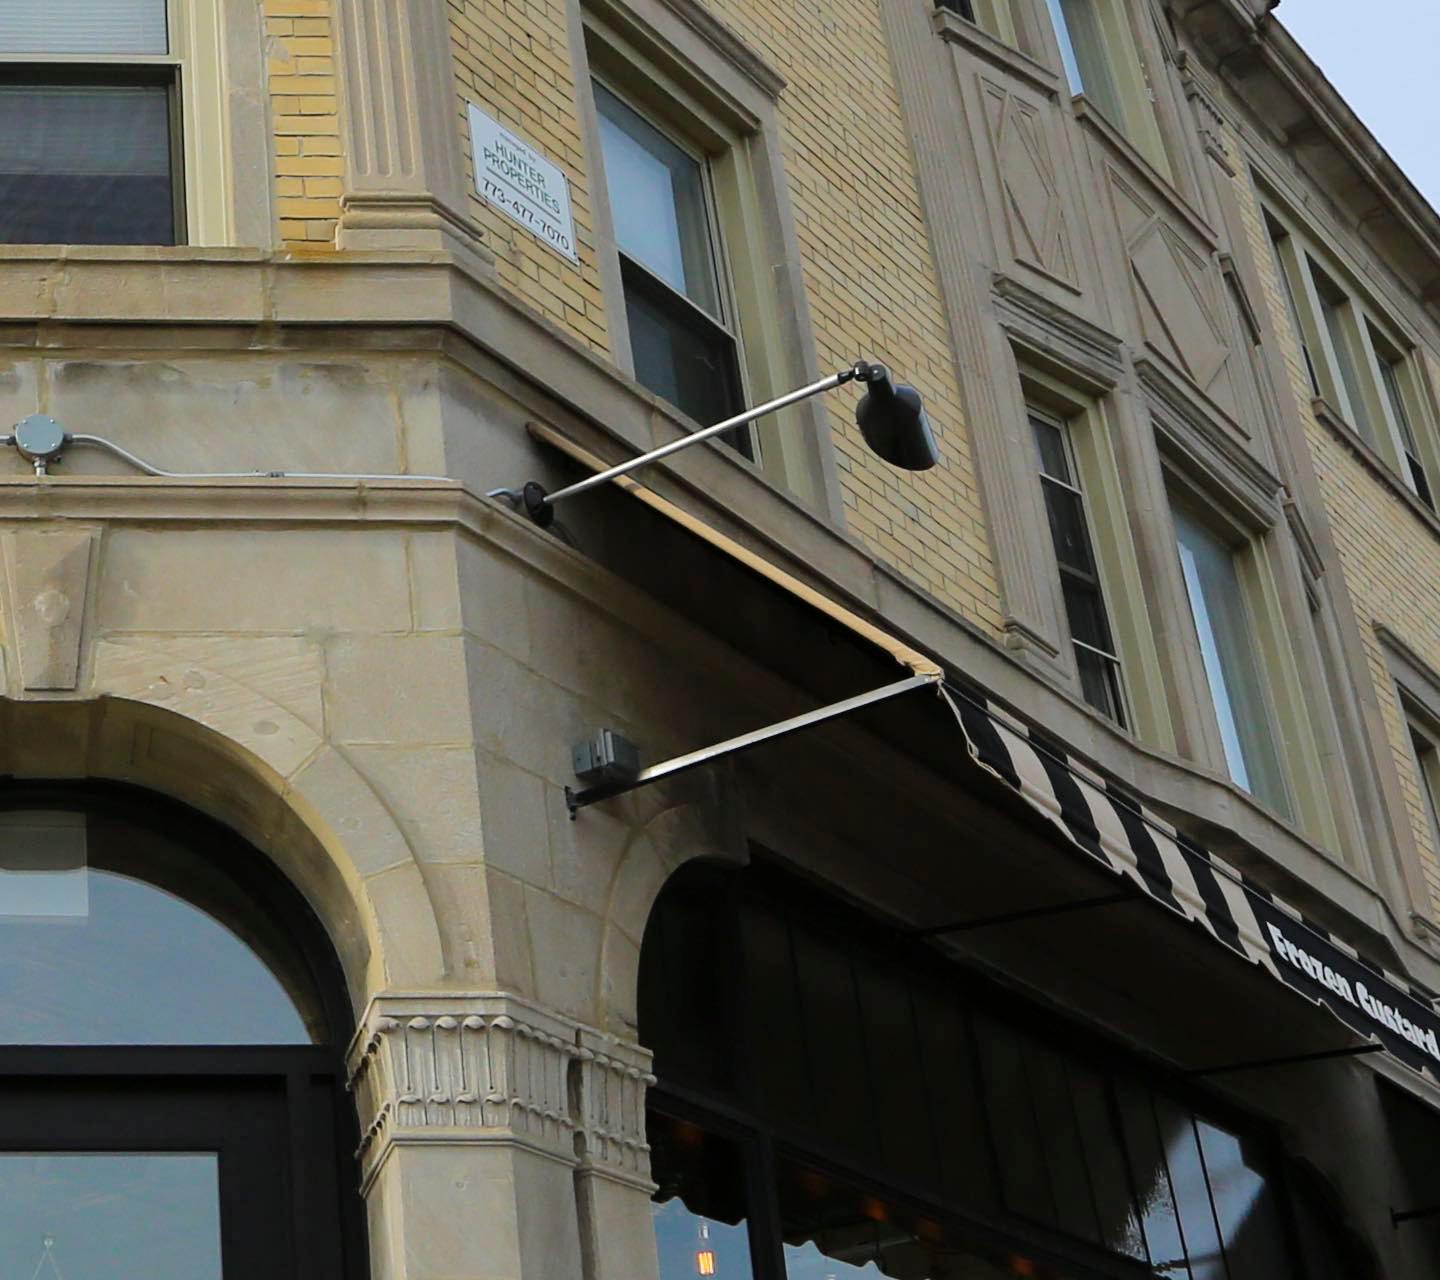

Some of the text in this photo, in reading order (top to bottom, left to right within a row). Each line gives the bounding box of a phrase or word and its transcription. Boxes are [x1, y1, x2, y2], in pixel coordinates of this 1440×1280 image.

[483, 147, 560, 214] PROPERTIES
[495, 140, 546, 189] HUNTER
[483, 177, 569, 250] 773-477-7070
[1266, 921, 1359, 1008] Frozen
